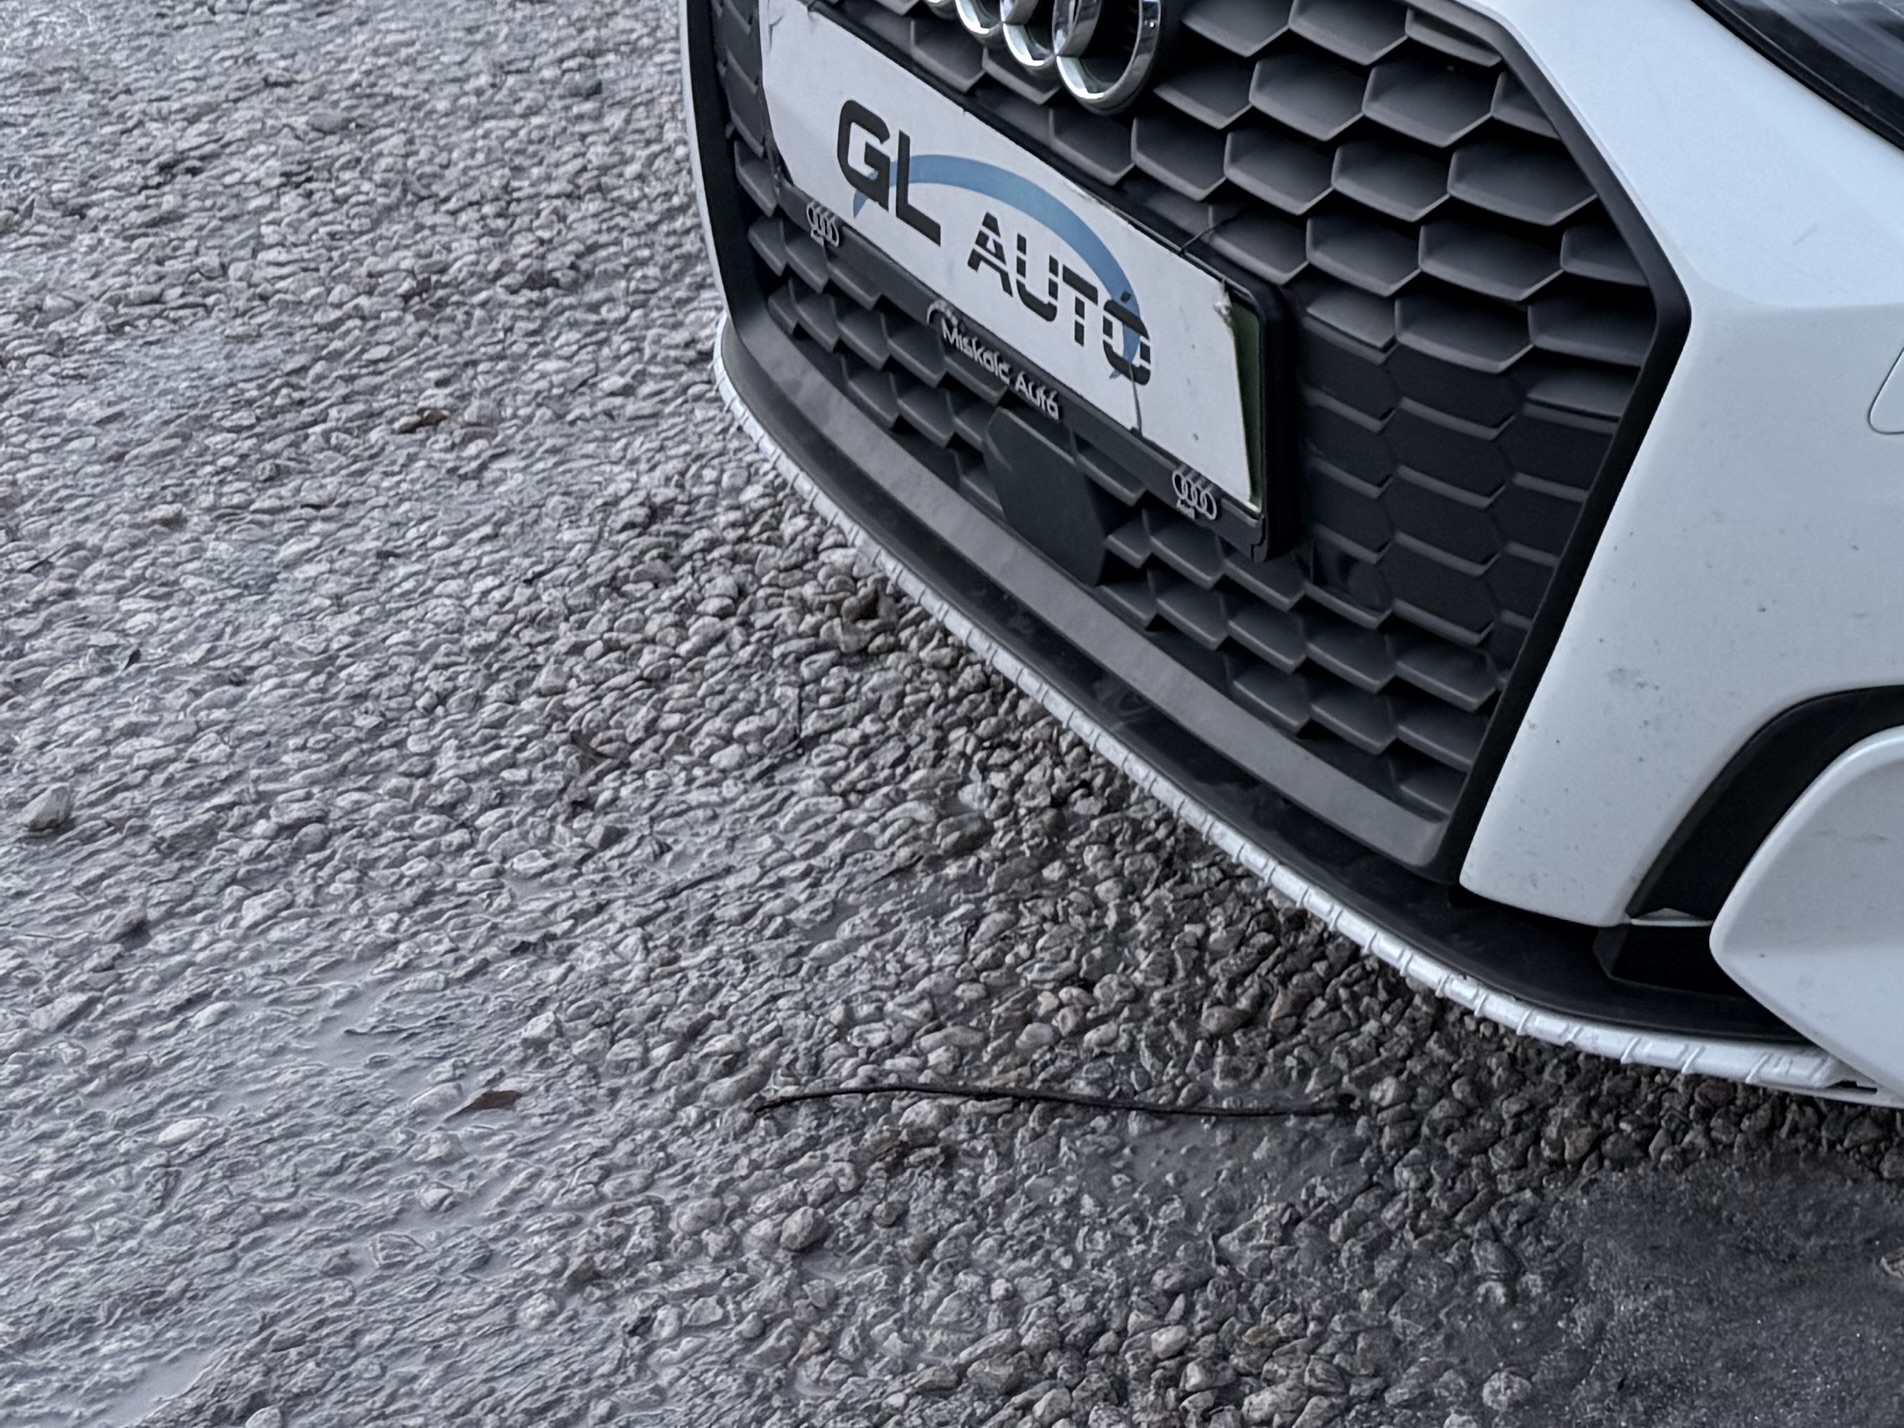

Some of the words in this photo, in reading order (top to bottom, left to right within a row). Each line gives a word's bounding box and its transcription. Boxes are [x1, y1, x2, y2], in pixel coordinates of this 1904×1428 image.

[837, 99, 942, 246] GL
[967, 211, 1152, 387] AUTÓ
[940, 318, 1011, 385] Miskolc
